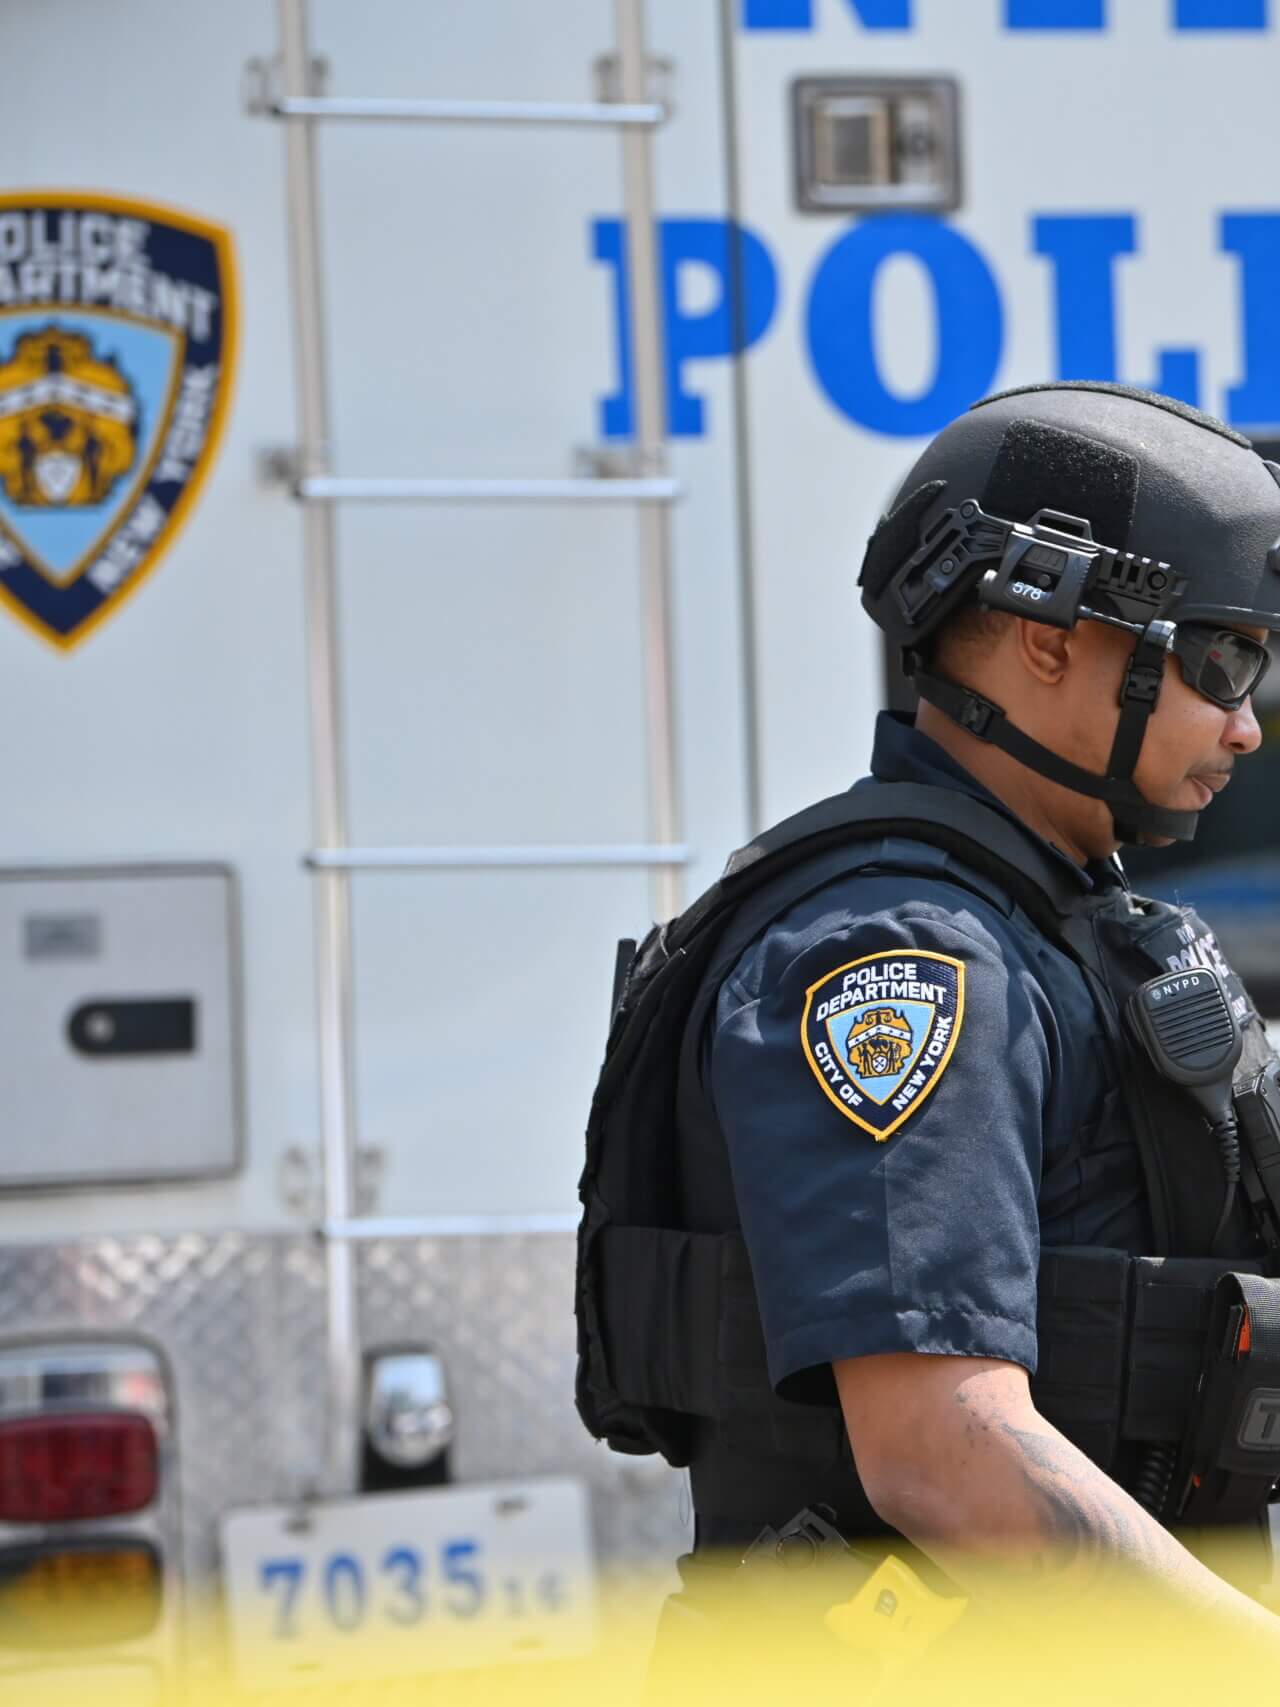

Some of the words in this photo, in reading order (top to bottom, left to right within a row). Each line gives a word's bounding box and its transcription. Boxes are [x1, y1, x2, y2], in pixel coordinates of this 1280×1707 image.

[0, 211, 150, 264] OLICE
[0, 260, 216, 343] ARTMENT
[86, 494, 164, 593] NEW
[153, 363, 219, 483] YORK
[816, 981, 948, 1022] DEPARTMENT
[842, 963, 918, 992] POLICE
[1162, 976, 1200, 996] NYPD
[814, 1041, 844, 1084] CITY
[839, 1083, 864, 1107] OF
[891, 1069, 927, 1111] NEW
[920, 1015, 953, 1067] YORK
[259, 1538, 488, 1640] 7035
